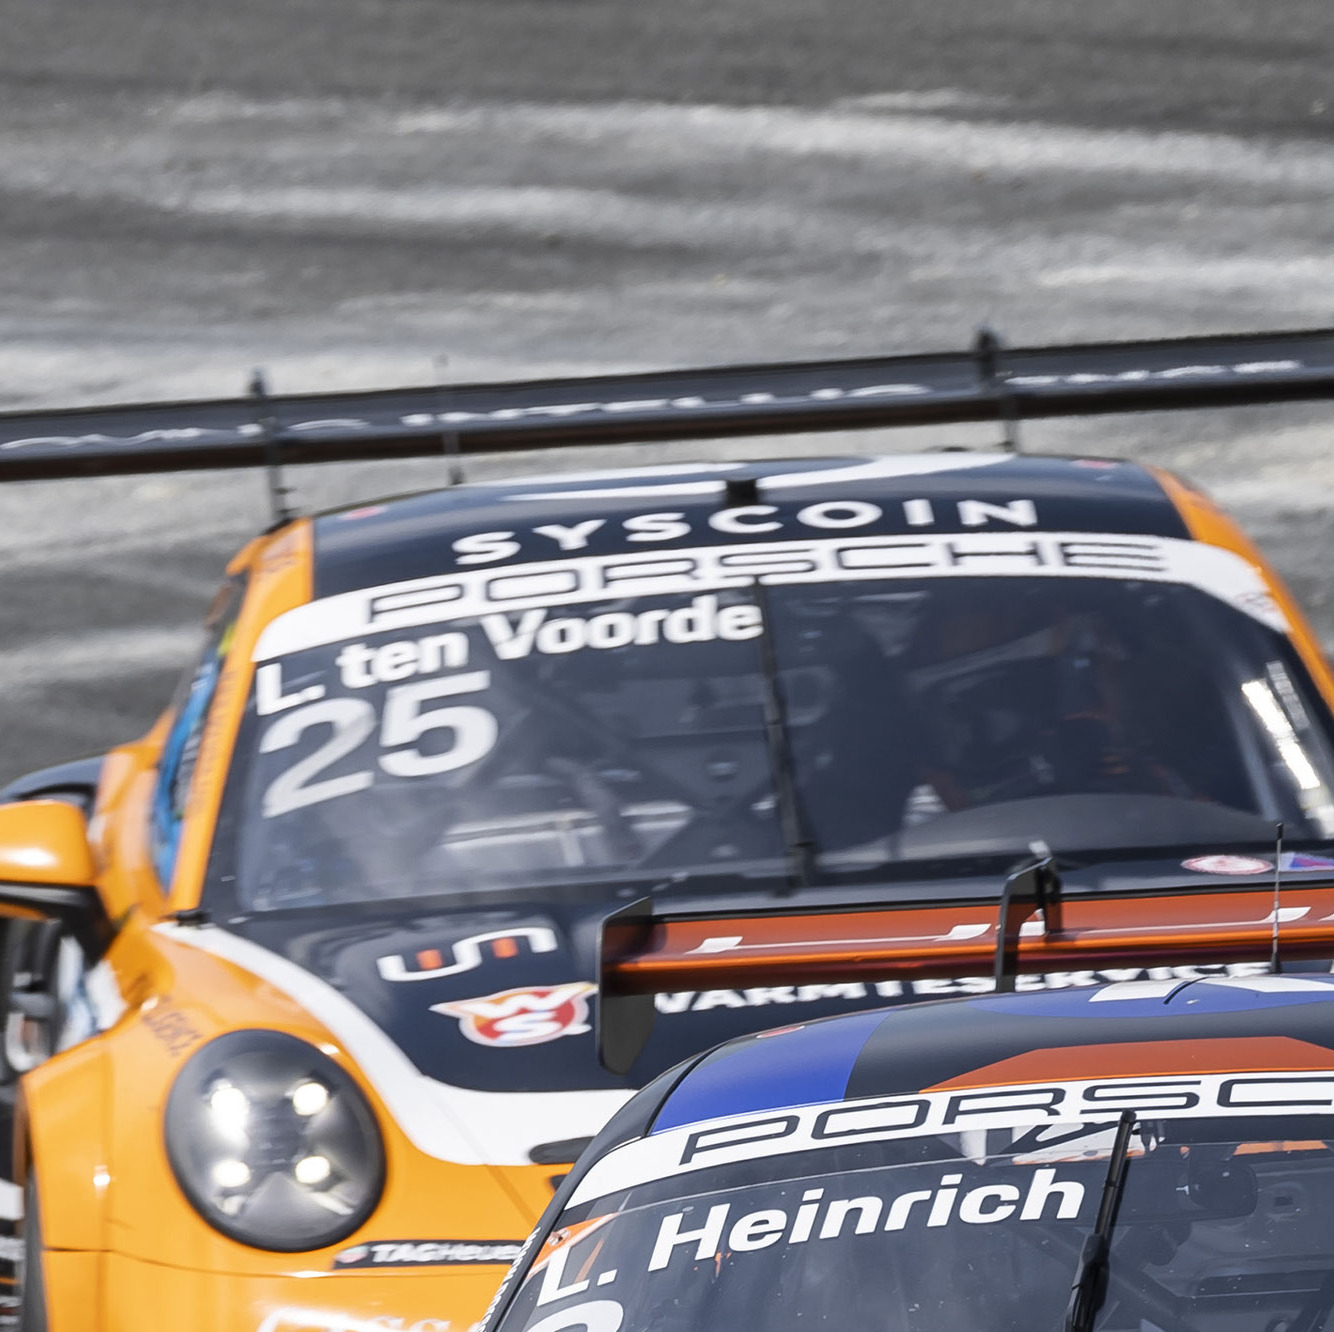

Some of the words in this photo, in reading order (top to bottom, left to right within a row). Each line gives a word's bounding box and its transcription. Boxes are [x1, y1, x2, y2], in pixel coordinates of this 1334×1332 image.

[370, 540, 1170, 625] PORSCHE
[452, 498, 1037, 566] SYSCOIN
[256, 665, 325, 716] L.
[337, 631, 468, 691] ten
[480, 596, 764, 661] Voorde
[258, 671, 498, 818] 25
[536, 1247, 618, 1307] L.
[647, 1168, 1086, 1272] Heinrich
